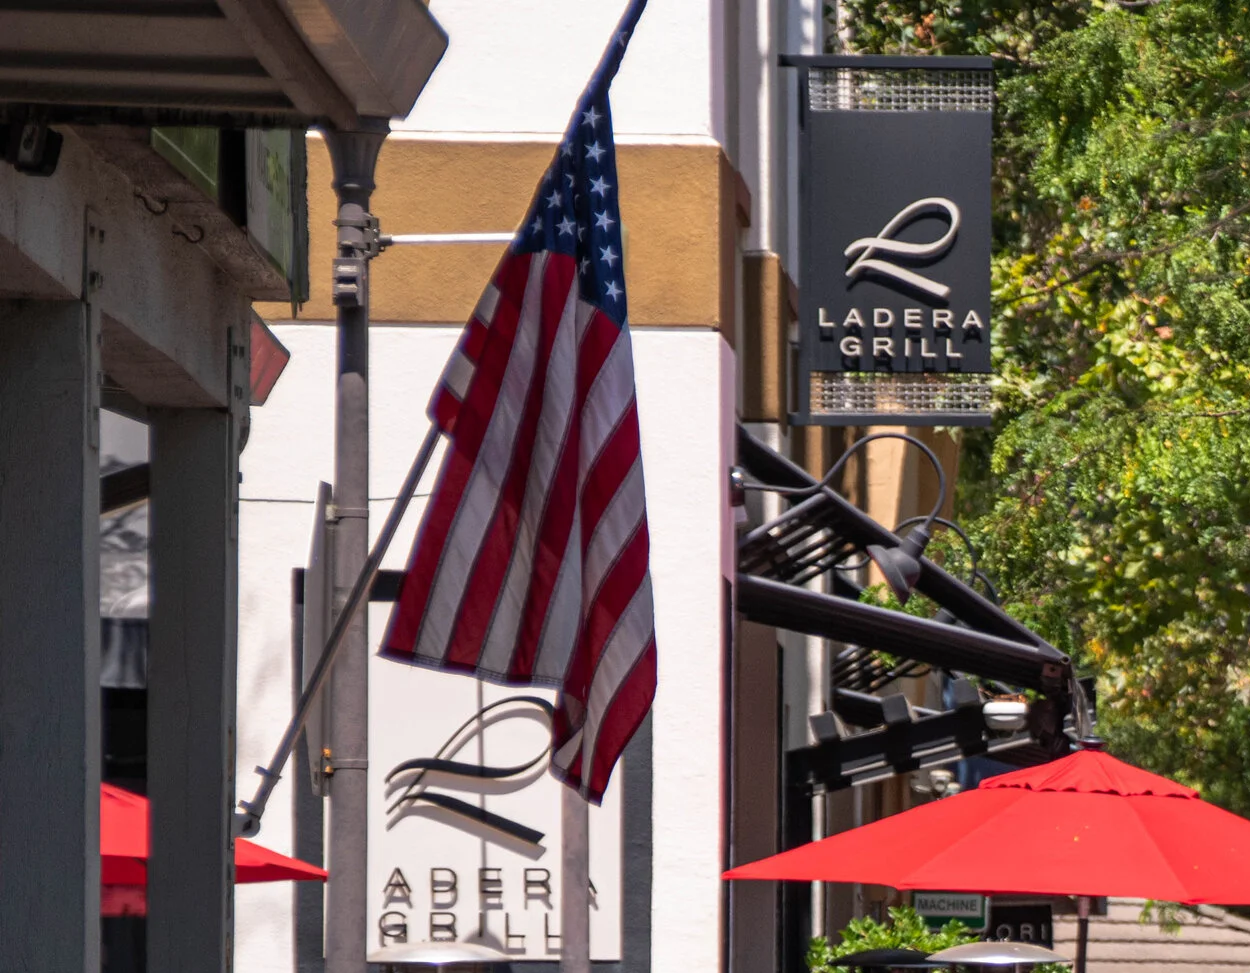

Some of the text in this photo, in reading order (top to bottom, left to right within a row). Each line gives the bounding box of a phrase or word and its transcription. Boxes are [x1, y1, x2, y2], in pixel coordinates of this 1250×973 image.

[818, 307, 983, 329] LADERA
[839, 336, 962, 358] GRILL
[383, 867, 598, 894] ADER
[917, 898, 978, 912] MACHINE
[378, 910, 562, 939] GRILL
